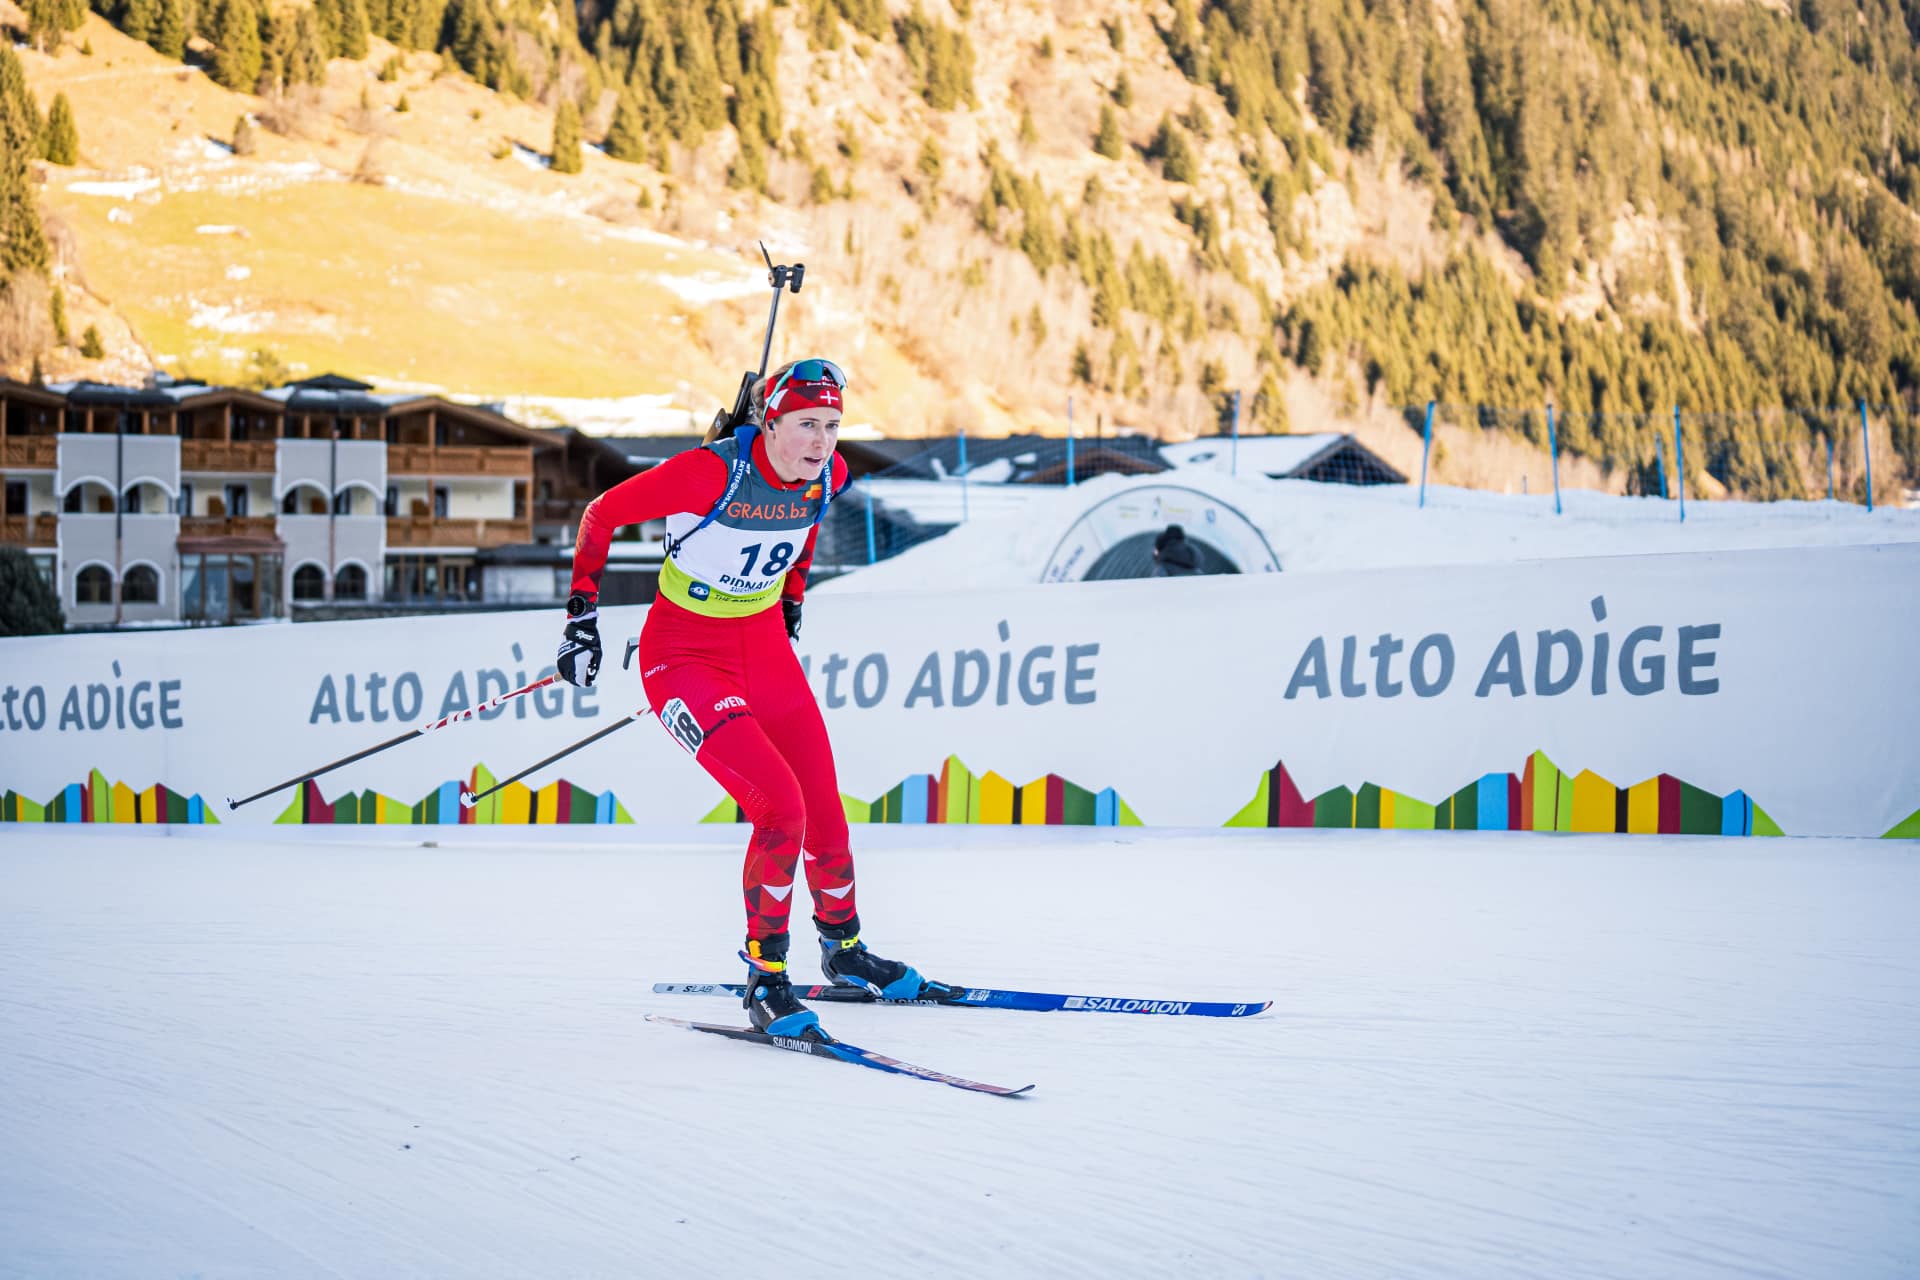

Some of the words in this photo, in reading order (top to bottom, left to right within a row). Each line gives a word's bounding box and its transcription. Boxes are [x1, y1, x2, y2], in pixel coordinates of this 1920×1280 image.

[726, 501, 809, 520] GRAUS.bz
[740, 541, 794, 577] 18
[673, 711, 703, 754] 18
[1082, 996, 1192, 1016] SALOMON
[772, 1036, 812, 1054] SALOMON
